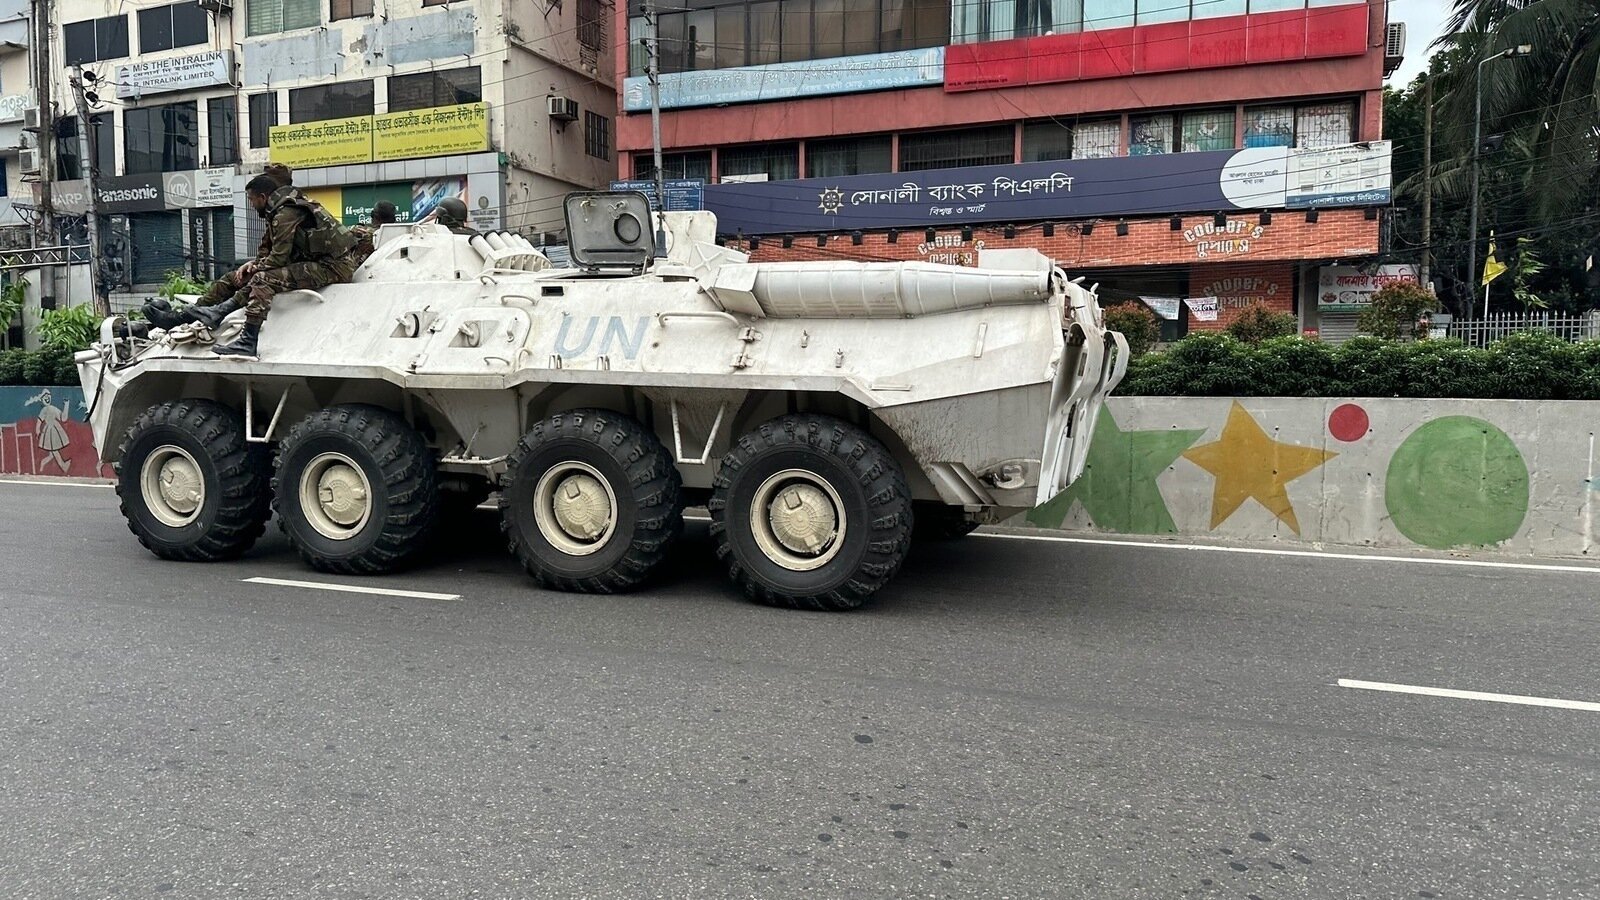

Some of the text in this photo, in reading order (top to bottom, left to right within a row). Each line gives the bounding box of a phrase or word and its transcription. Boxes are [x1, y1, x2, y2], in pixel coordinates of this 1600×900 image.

[133, 52, 222, 73] M/S THE INTRALINK
[142, 75, 182, 87] INTRALINK
[184, 71, 215, 81] LIMITED
[50, 192, 82, 206] HARP
[171, 182, 188, 197] KDK
[850, 172, 1075, 206] সোনালী ব্যাংক পিএলসি
[917, 234, 985, 255] Coope's
[553, 315, 651, 360] UN
